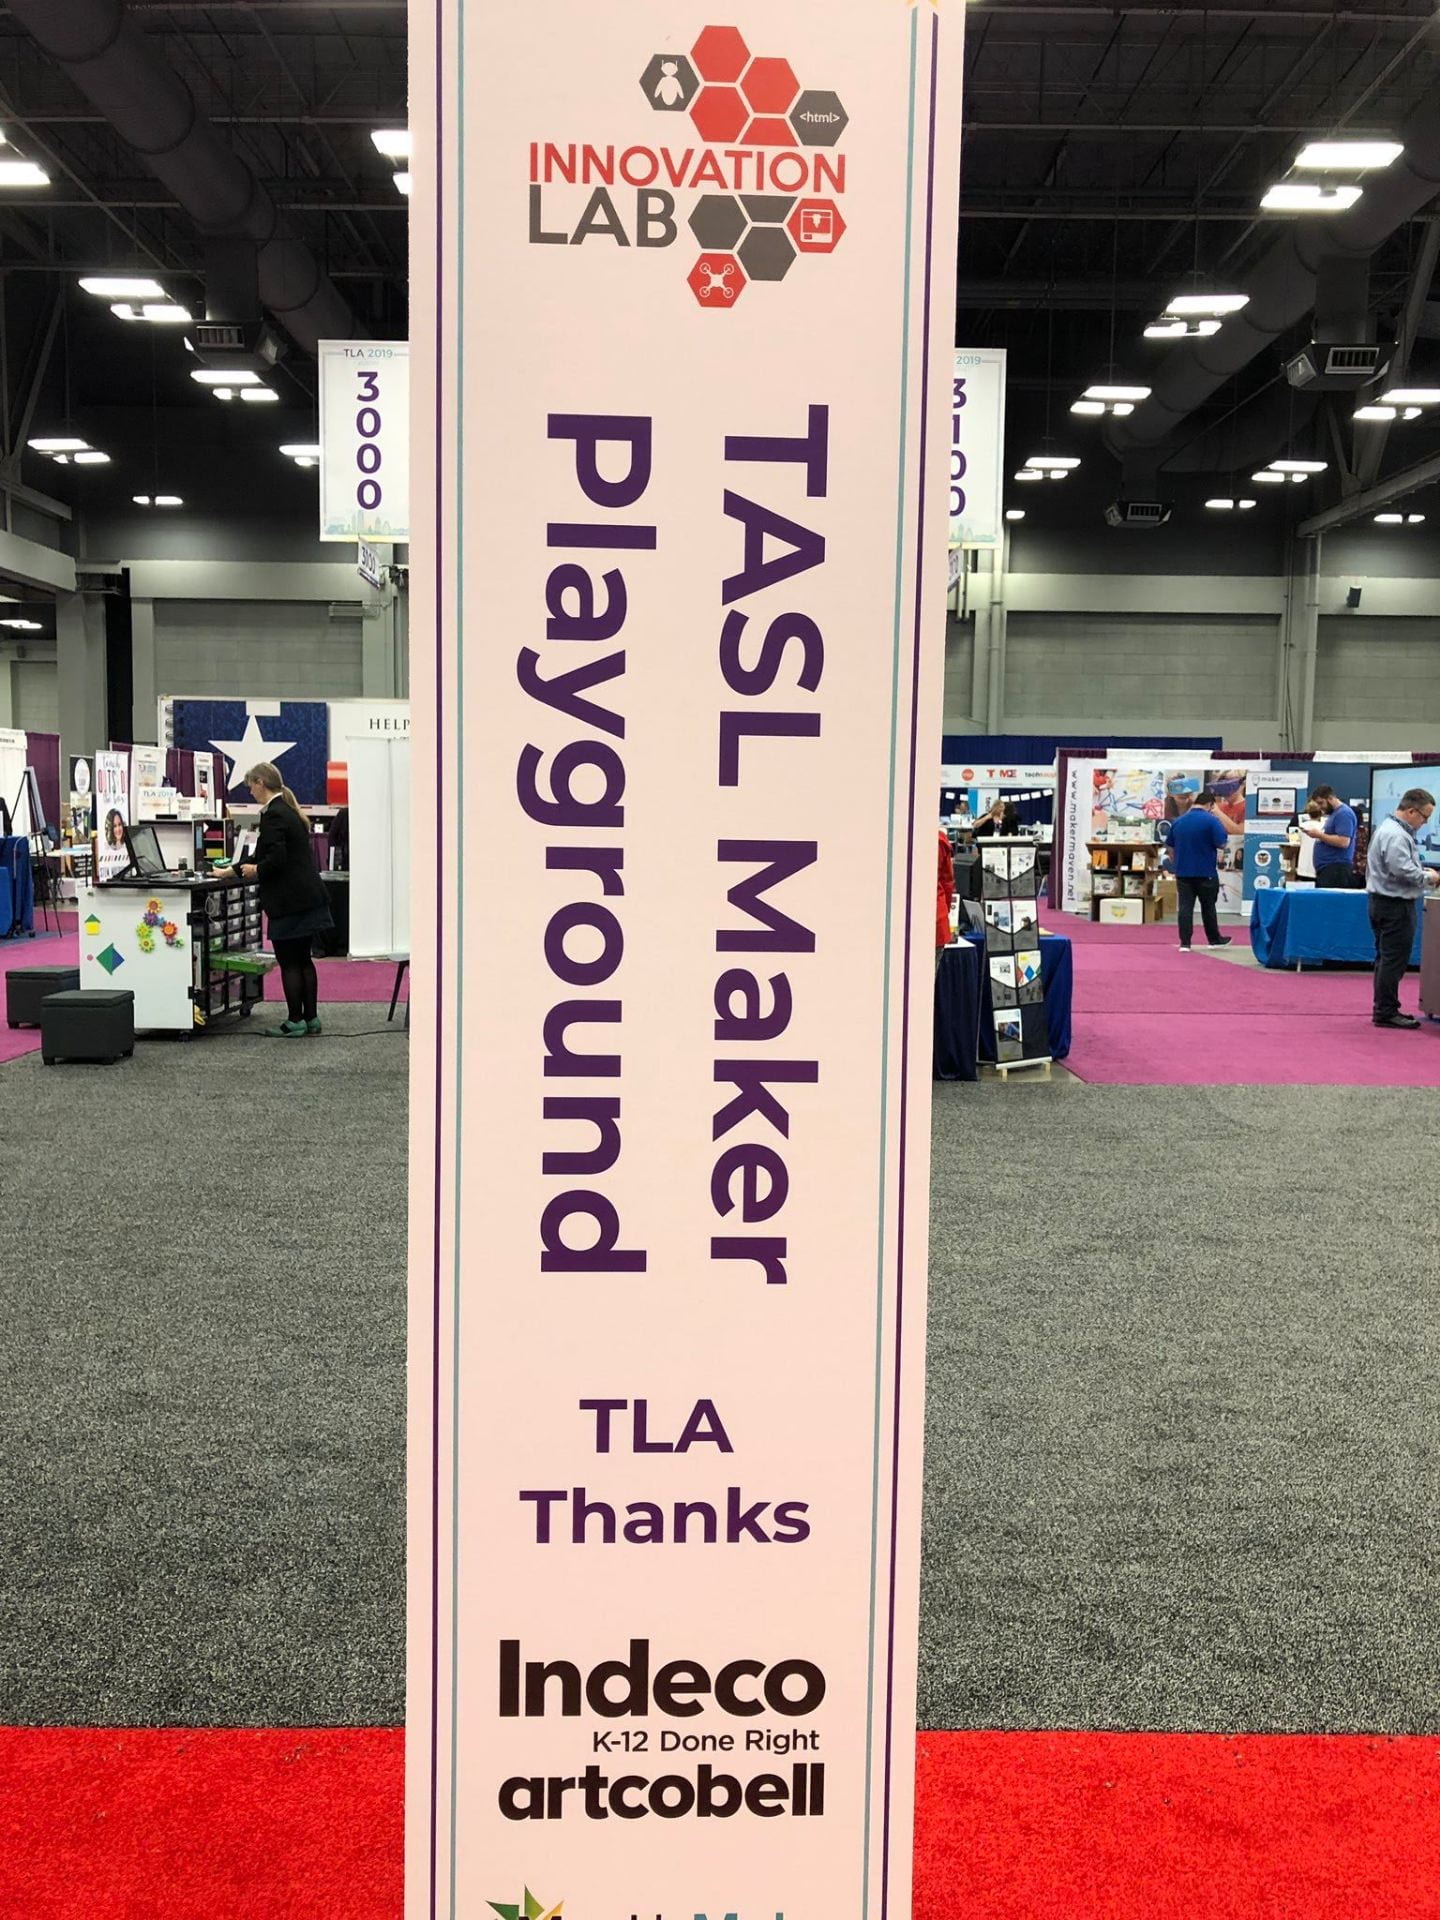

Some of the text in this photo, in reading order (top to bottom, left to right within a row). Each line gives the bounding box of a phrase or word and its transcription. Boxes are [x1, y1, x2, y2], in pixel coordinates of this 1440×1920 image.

[800, 111, 840, 123] <html>
[530, 143, 846, 194] INNOVATION
[530, 184, 678, 248] LAB
[343, 349, 393, 359] TLA 2019
[956, 355, 981, 365] 2019
[356, 371, 382, 510] 3000
[517, 414, 657, 1273] Playground
[711, 404, 828, 1285] TASL Maker
[1067, 770, 1078, 901] www.makermaven.net
[579, 1399, 735, 1454] TLA
[519, 1487, 811, 1545] Thanks
[499, 1638, 827, 1718] Indeco
[593, 1728, 820, 1756] K-12 Done Right
[498, 1763, 826, 1821] artcobell
